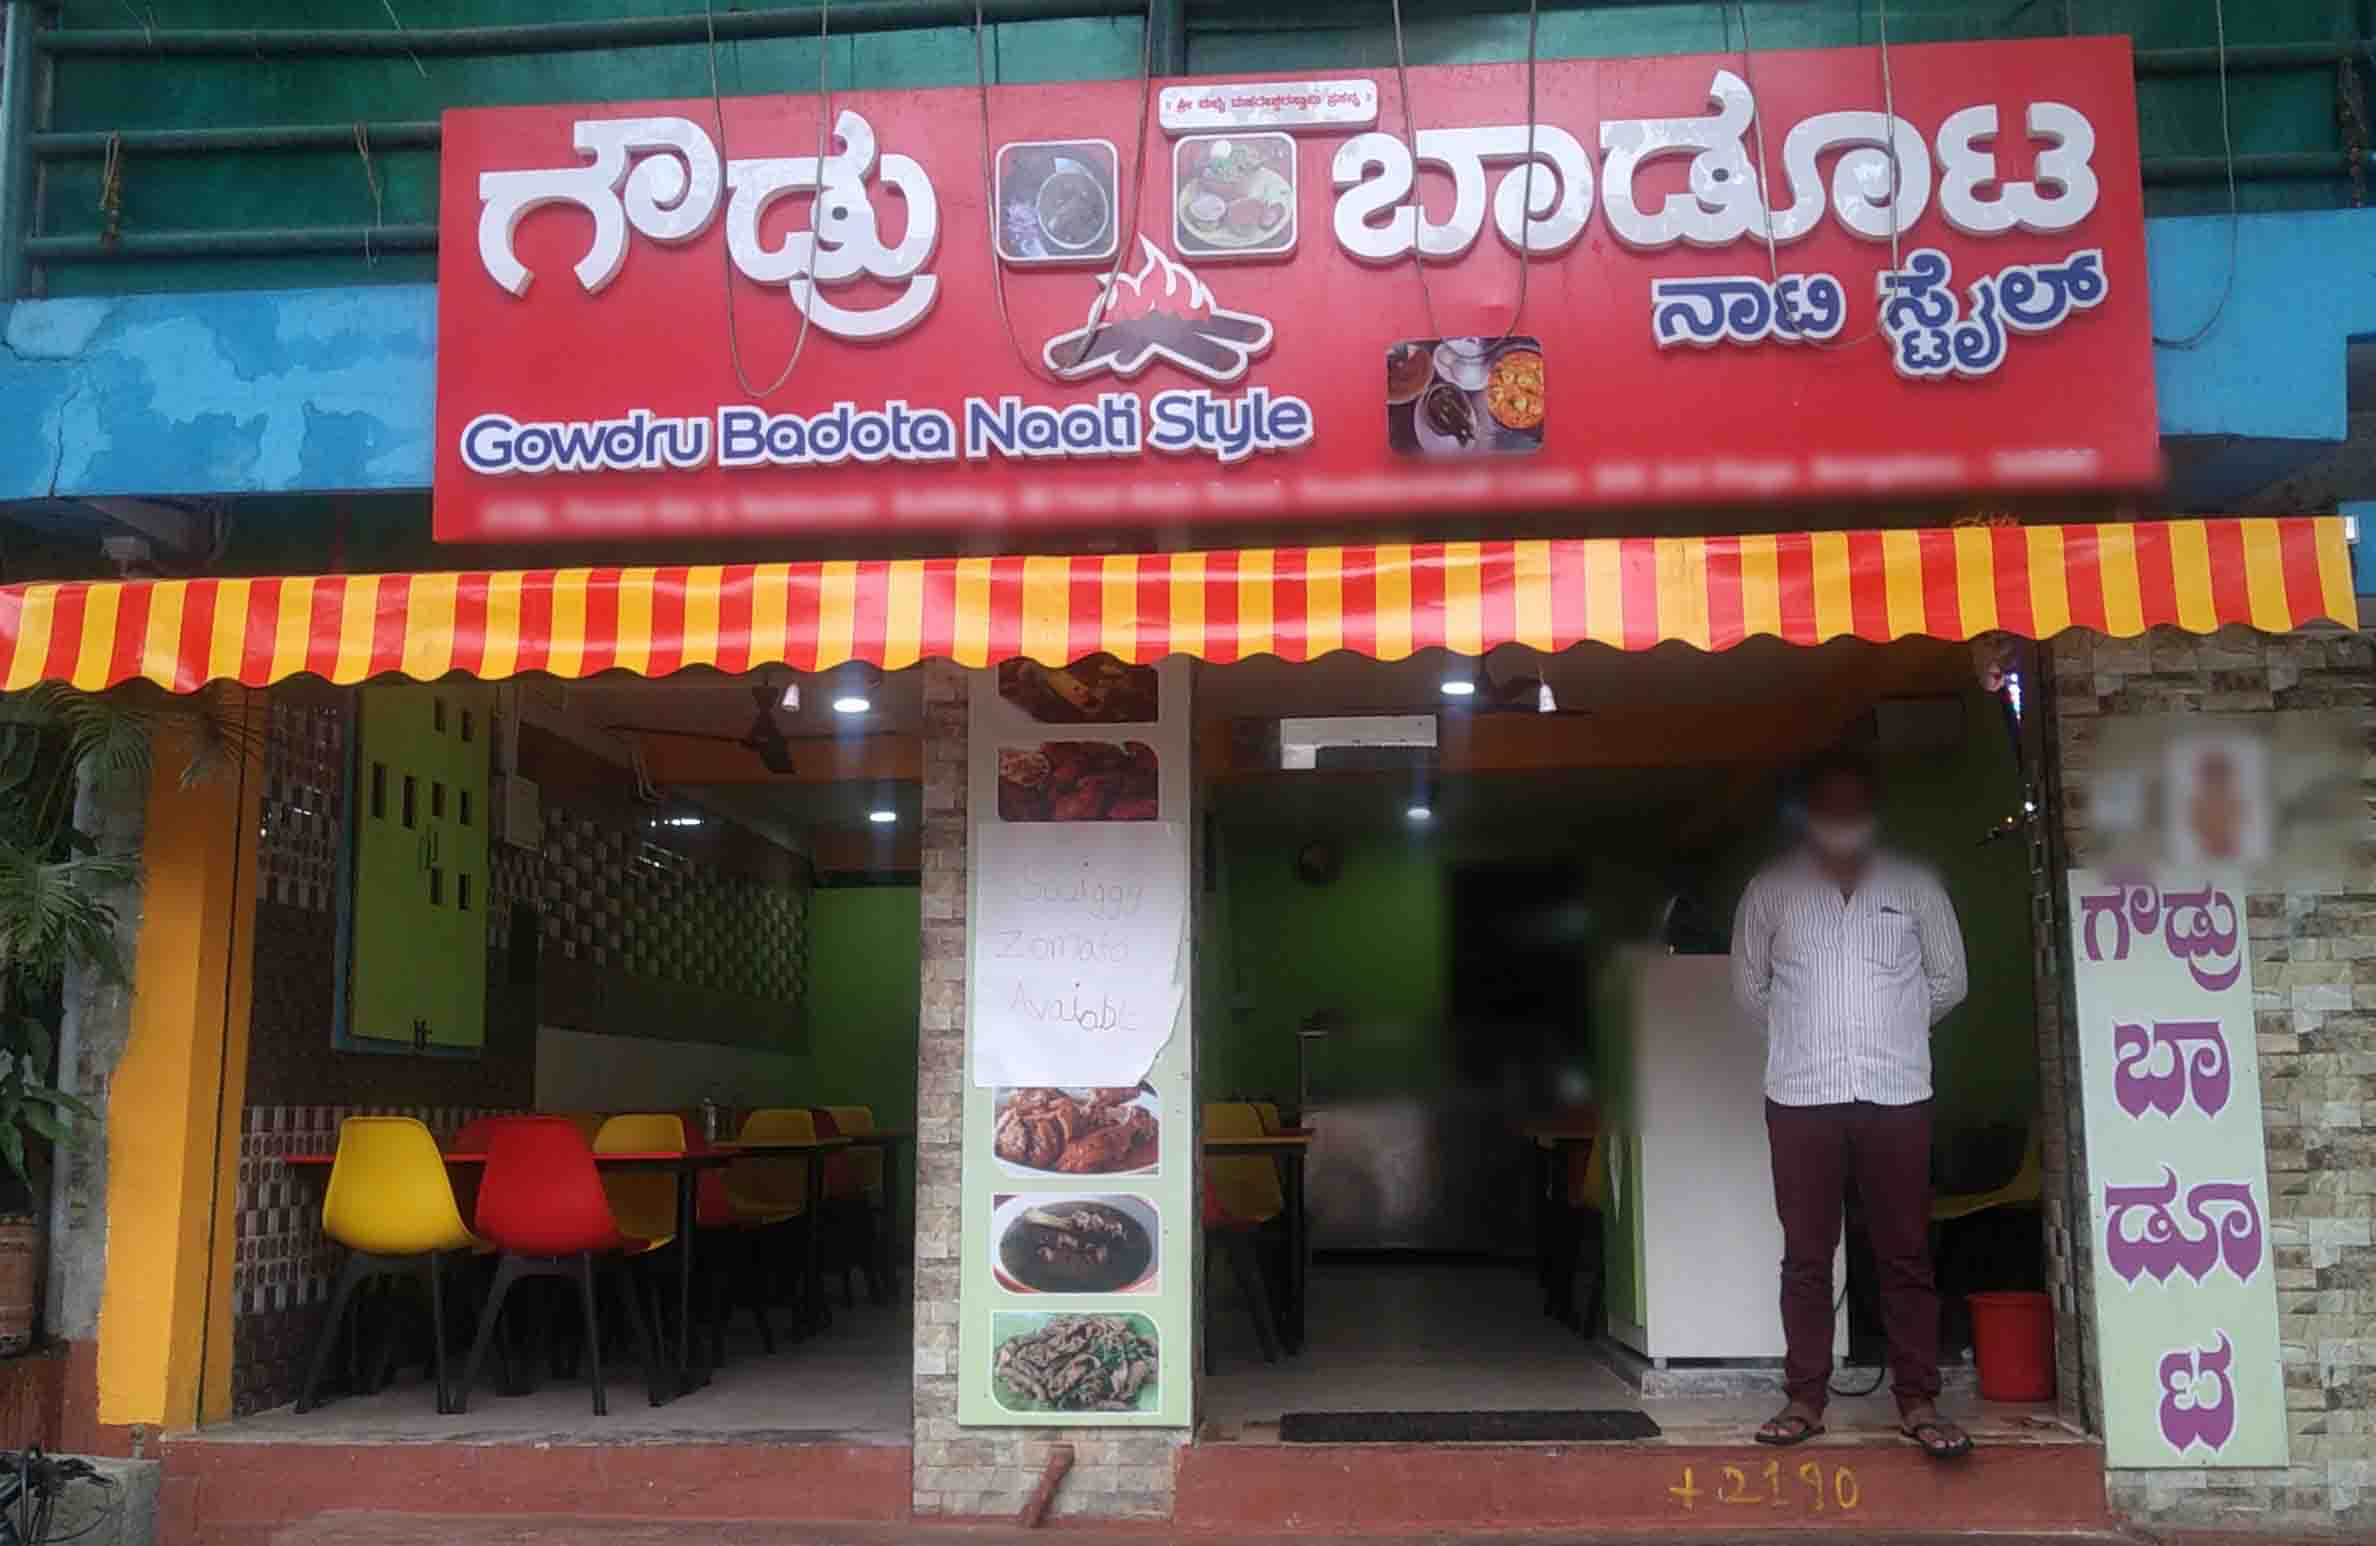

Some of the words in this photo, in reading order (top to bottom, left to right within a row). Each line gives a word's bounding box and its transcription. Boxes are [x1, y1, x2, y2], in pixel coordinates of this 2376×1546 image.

[479, 109, 938, 339] ಗೌಡ್ರು
[1332, 69, 2099, 263] ಬಾಡೂಟ
[1654, 276, 1844, 344] ನಾಟಿ
[1880, 250, 2105, 377] ಸ್ಟೈಲ್
[464, 410, 707, 472] Gowdru
[721, 404, 951, 464] Badota
[969, 394, 1141, 456] Naati
[1151, 389, 1311, 458] Style
